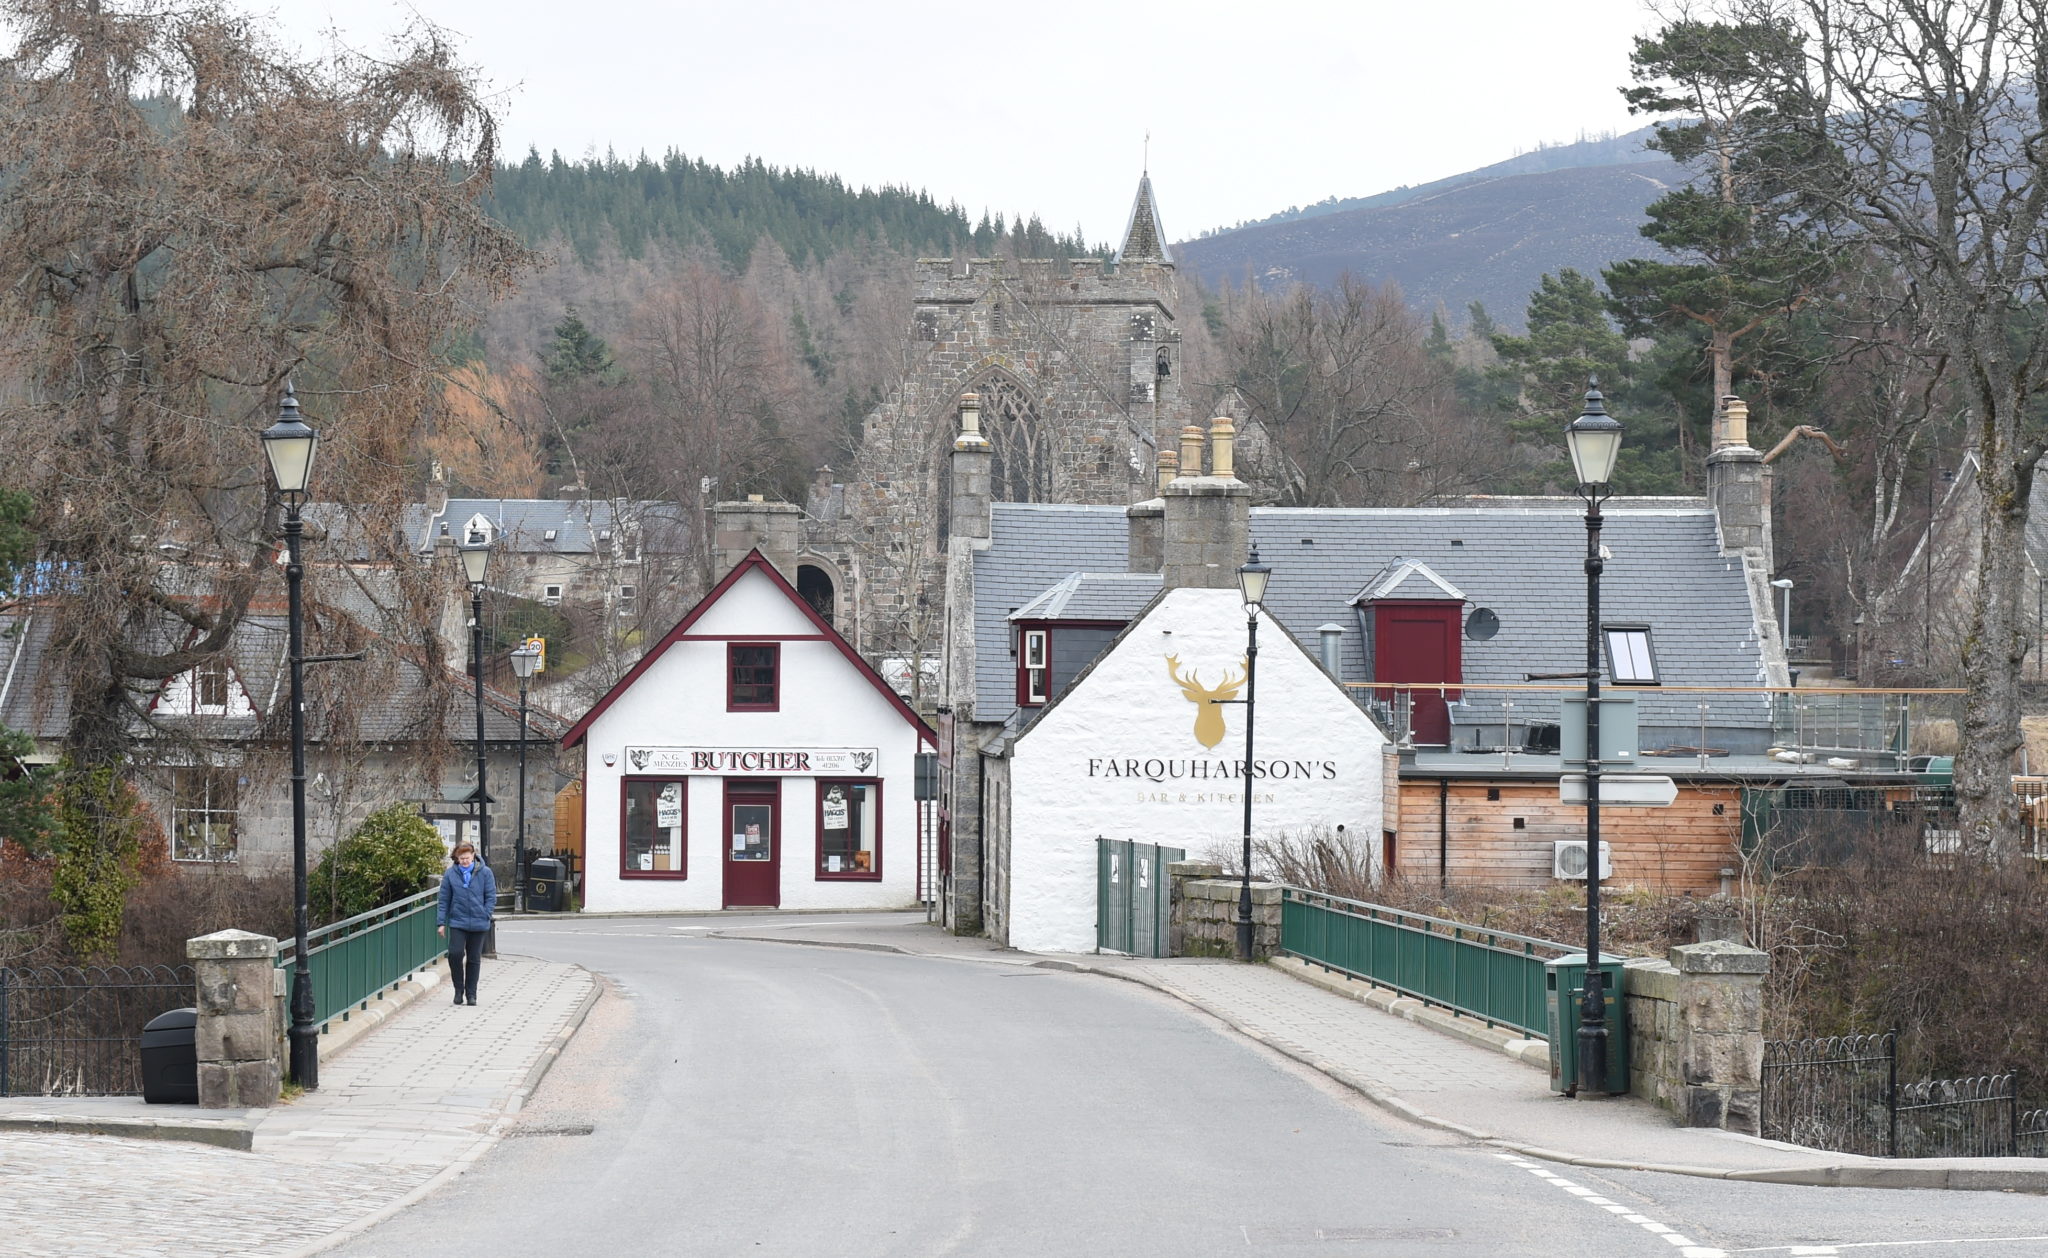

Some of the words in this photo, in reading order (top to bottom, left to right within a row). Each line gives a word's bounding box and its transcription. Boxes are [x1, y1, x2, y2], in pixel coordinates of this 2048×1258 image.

[652, 760, 688, 768] MENZIES
[691, 751, 811, 771] BUTCHER
[1088, 758, 1337, 782] FARQUHARSON'S
[1137, 792, 1168, 803] BAR
[1178, 793, 1187, 803] &
